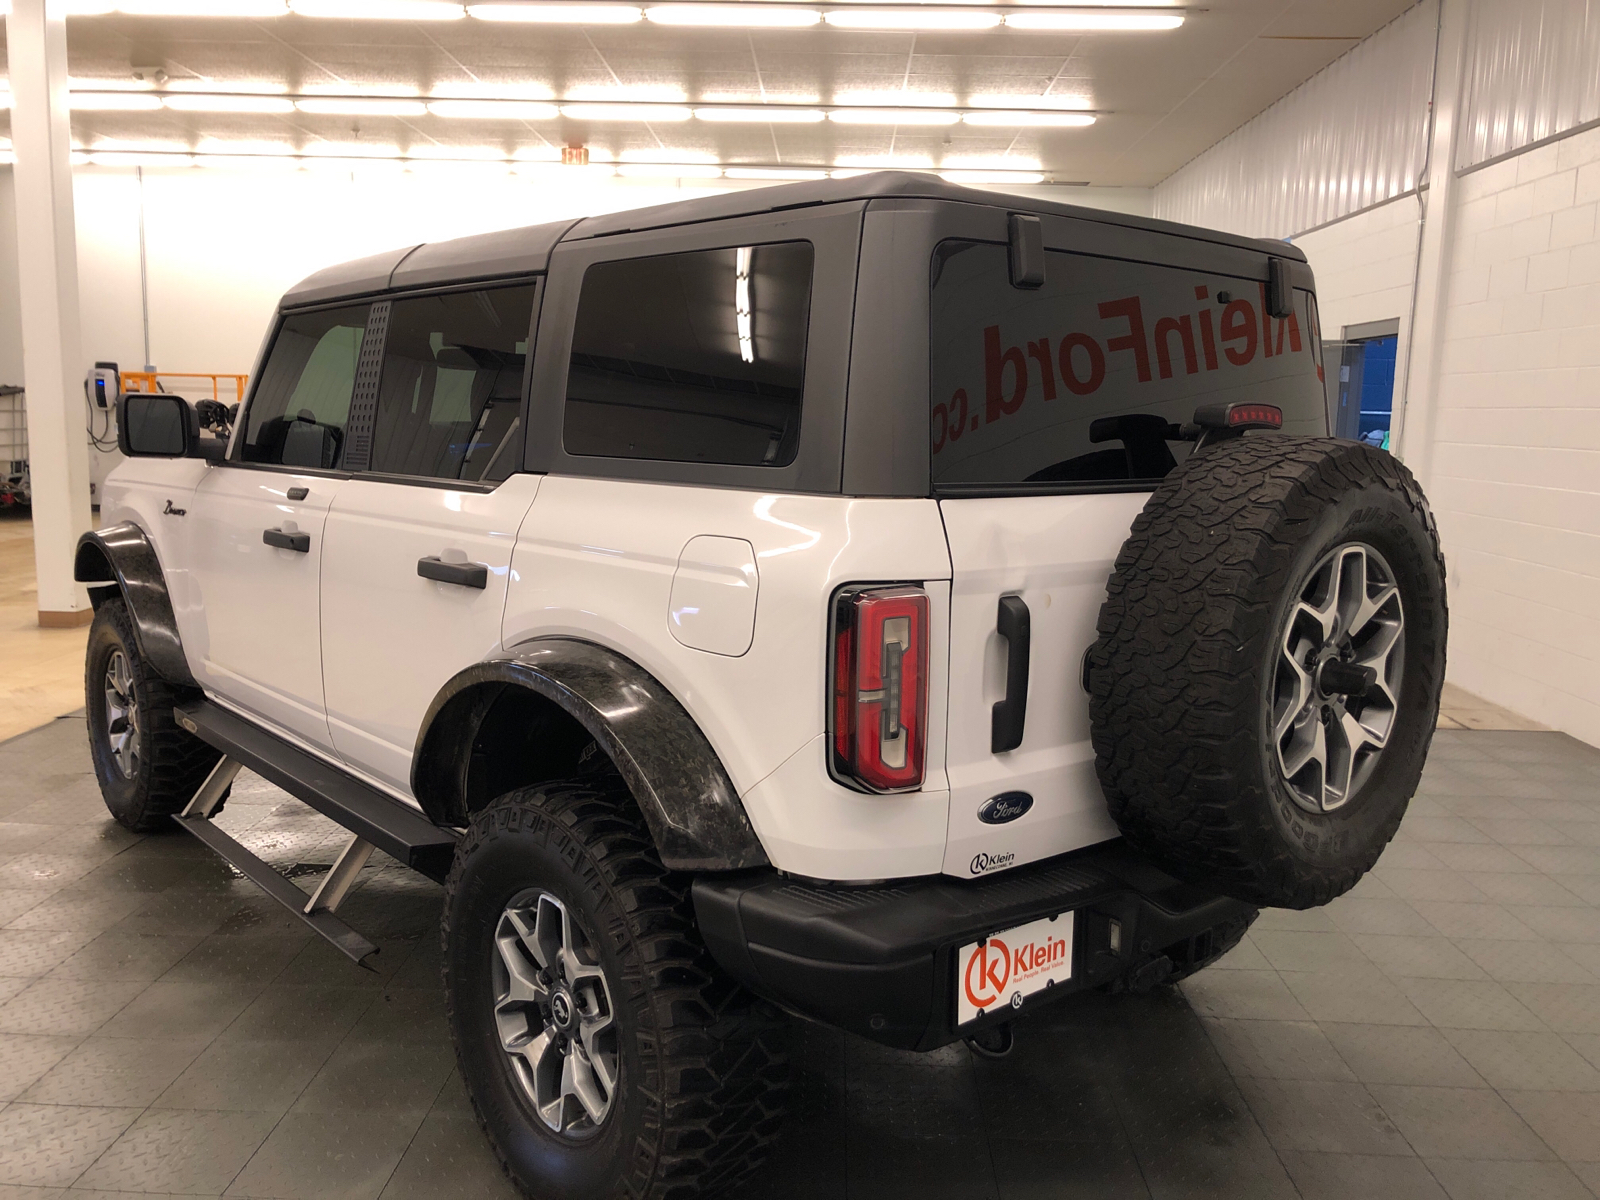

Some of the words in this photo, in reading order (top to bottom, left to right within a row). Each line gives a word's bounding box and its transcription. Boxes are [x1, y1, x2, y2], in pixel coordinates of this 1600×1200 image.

[564, 148, 586, 164] EXIT
[993, 800, 1023, 819] Ford
[989, 852, 1015, 866] Klein
[1013, 935, 1066, 976] Klein
[1012, 975, 1023, 984] Real
[1040, 965, 1051, 973] Real
